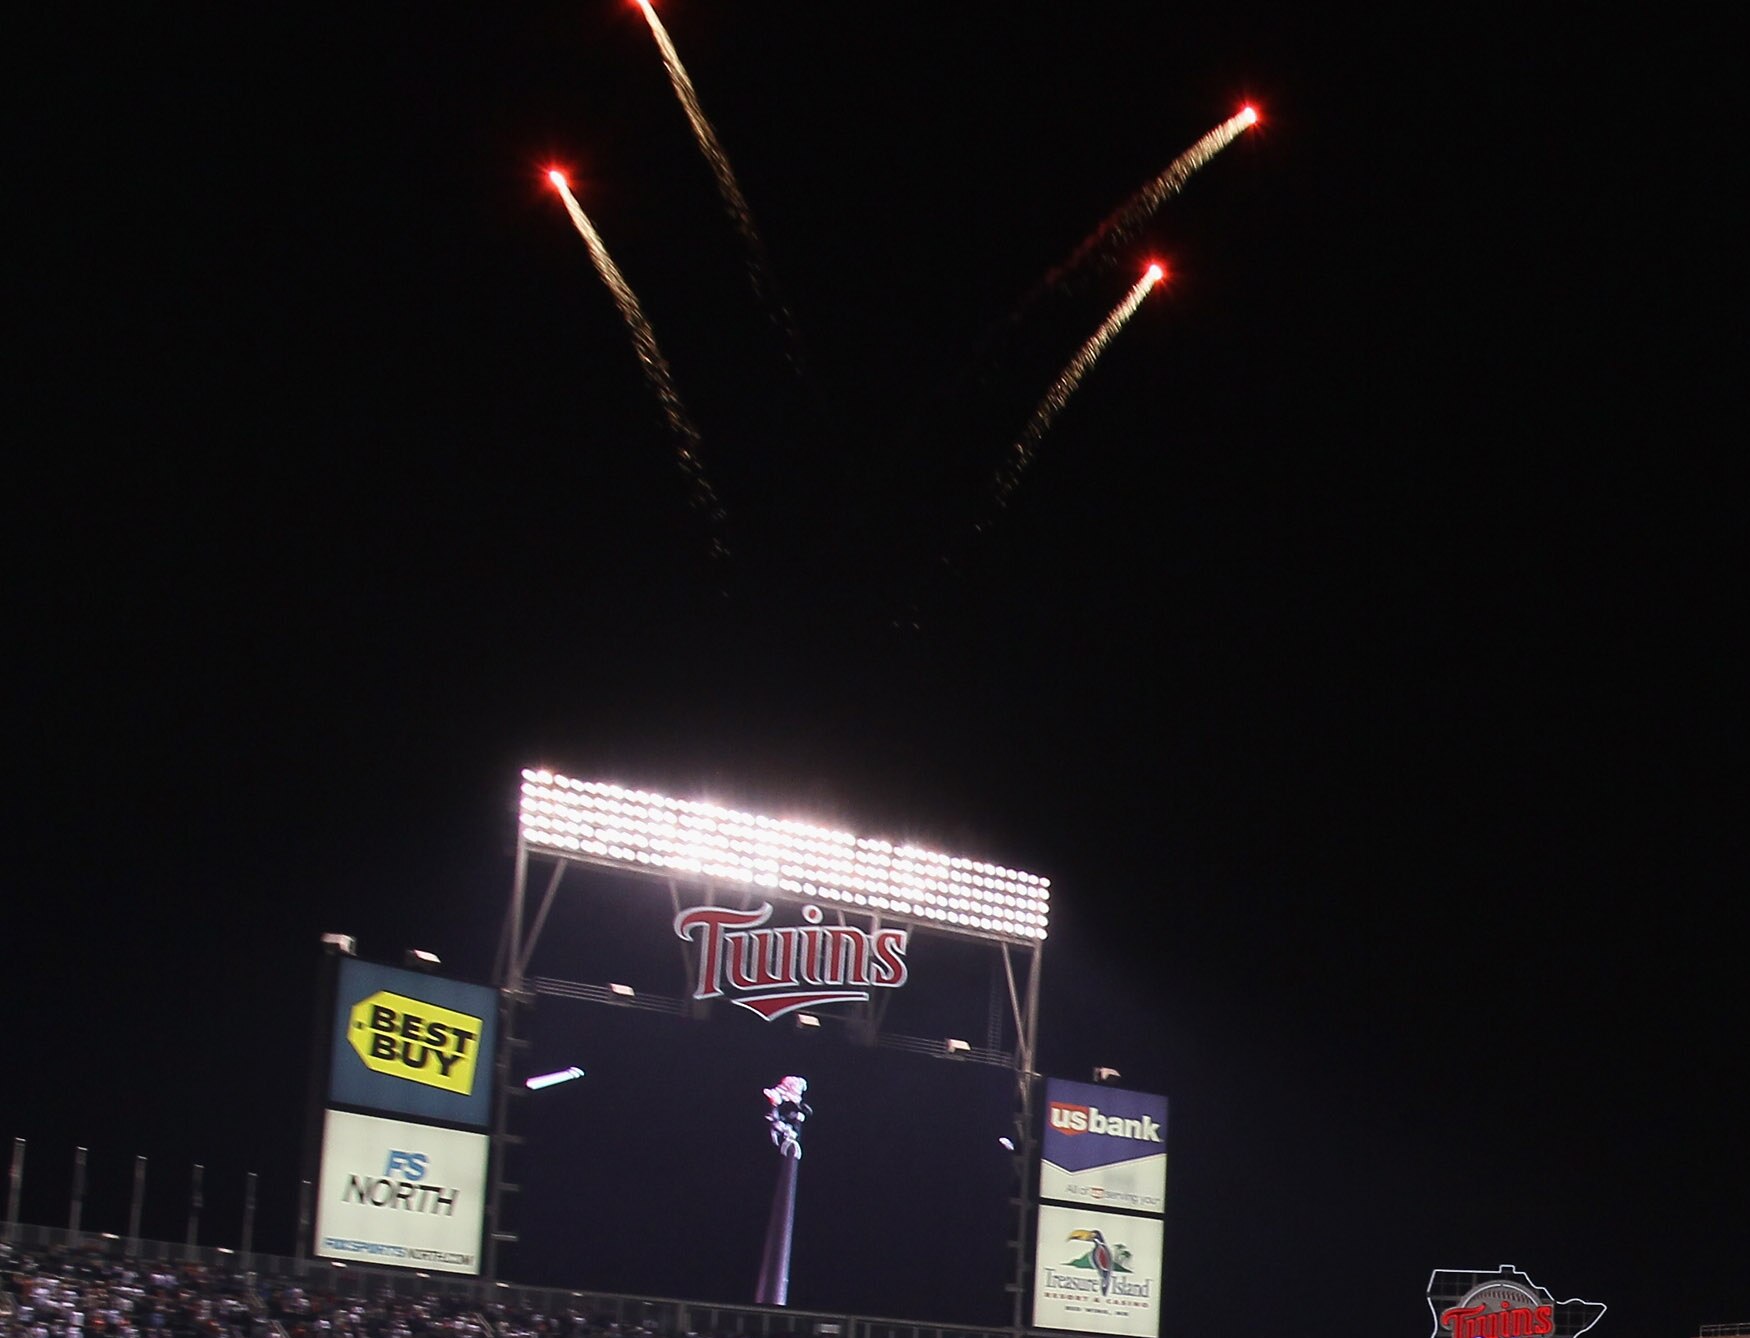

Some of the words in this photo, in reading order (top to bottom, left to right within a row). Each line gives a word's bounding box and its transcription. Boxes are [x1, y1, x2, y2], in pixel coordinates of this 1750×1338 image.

[674, 901, 908, 999] Twins
[370, 1004, 476, 1053] BEST
[369, 1033, 462, 1078] BUY
[384, 1149, 429, 1181] FS
[341, 1174, 460, 1217] NORTH
[1044, 1267, 1099, 1293] Treasure
[1111, 1275, 1153, 1298] Island
[1044, 1292, 1089, 1301] RESORT
[1106, 1299, 1149, 1308] CASINO
